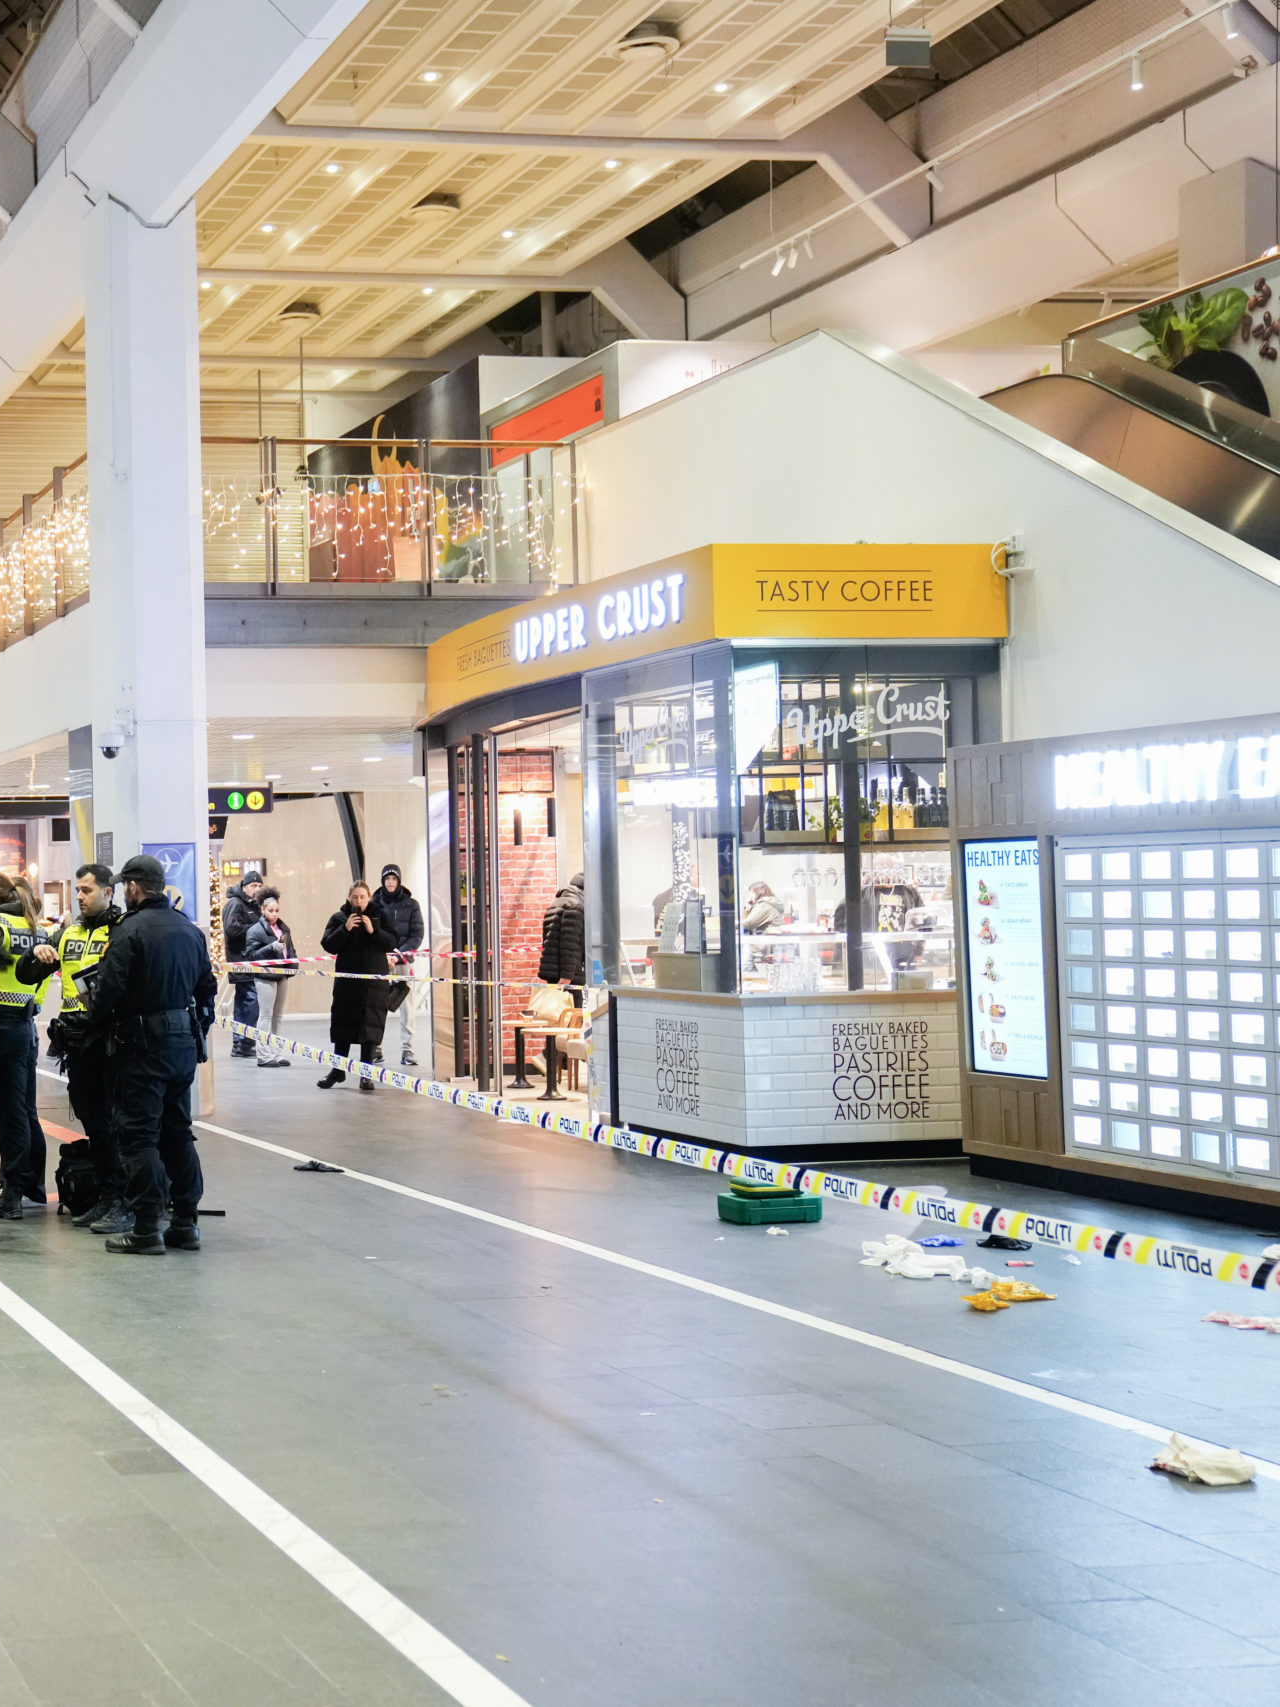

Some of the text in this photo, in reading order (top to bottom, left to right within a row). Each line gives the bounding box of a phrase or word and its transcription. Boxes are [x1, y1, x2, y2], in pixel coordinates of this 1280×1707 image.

[756, 580, 933, 601] TASTY COFFEE
[515, 573, 684, 663] UPPER CRUST
[457, 638, 511, 672] FRESH BAGUETTES
[787, 685, 951, 753] Upper Crust
[1238, 735, 1280, 799] E
[967, 849, 1040, 867] HEALTHY EATS
[66, 941, 105, 953] POLI
[656, 1019, 698, 1034] FRESHLY BAKED
[832, 1021, 928, 1036] FRESHLY BAKED
[656, 1031, 698, 1049] BAGUETTES
[833, 1035, 928, 1051] BAGUETTES
[656, 1046, 699, 1071] PASTRIES
[833, 1051, 928, 1074] PASTRIES
[656, 1068, 700, 1097] COFFEE
[832, 1074, 930, 1100] COFFEE
[658, 1094, 700, 1117] AND MORE
[834, 1101, 930, 1121] AND MORE
[560, 1117, 580, 1132] POLITI
[613, 1134, 637, 1151] POLITI
[675, 1144, 701, 1162] POLITI
[744, 1163, 773, 1183] POLITI
[824, 1176, 857, 1198] POLITI
[917, 1200, 956, 1223] POLITI
[1026, 1217, 1071, 1243] POLITI
[1157, 1247, 1212, 1277] POLITI
